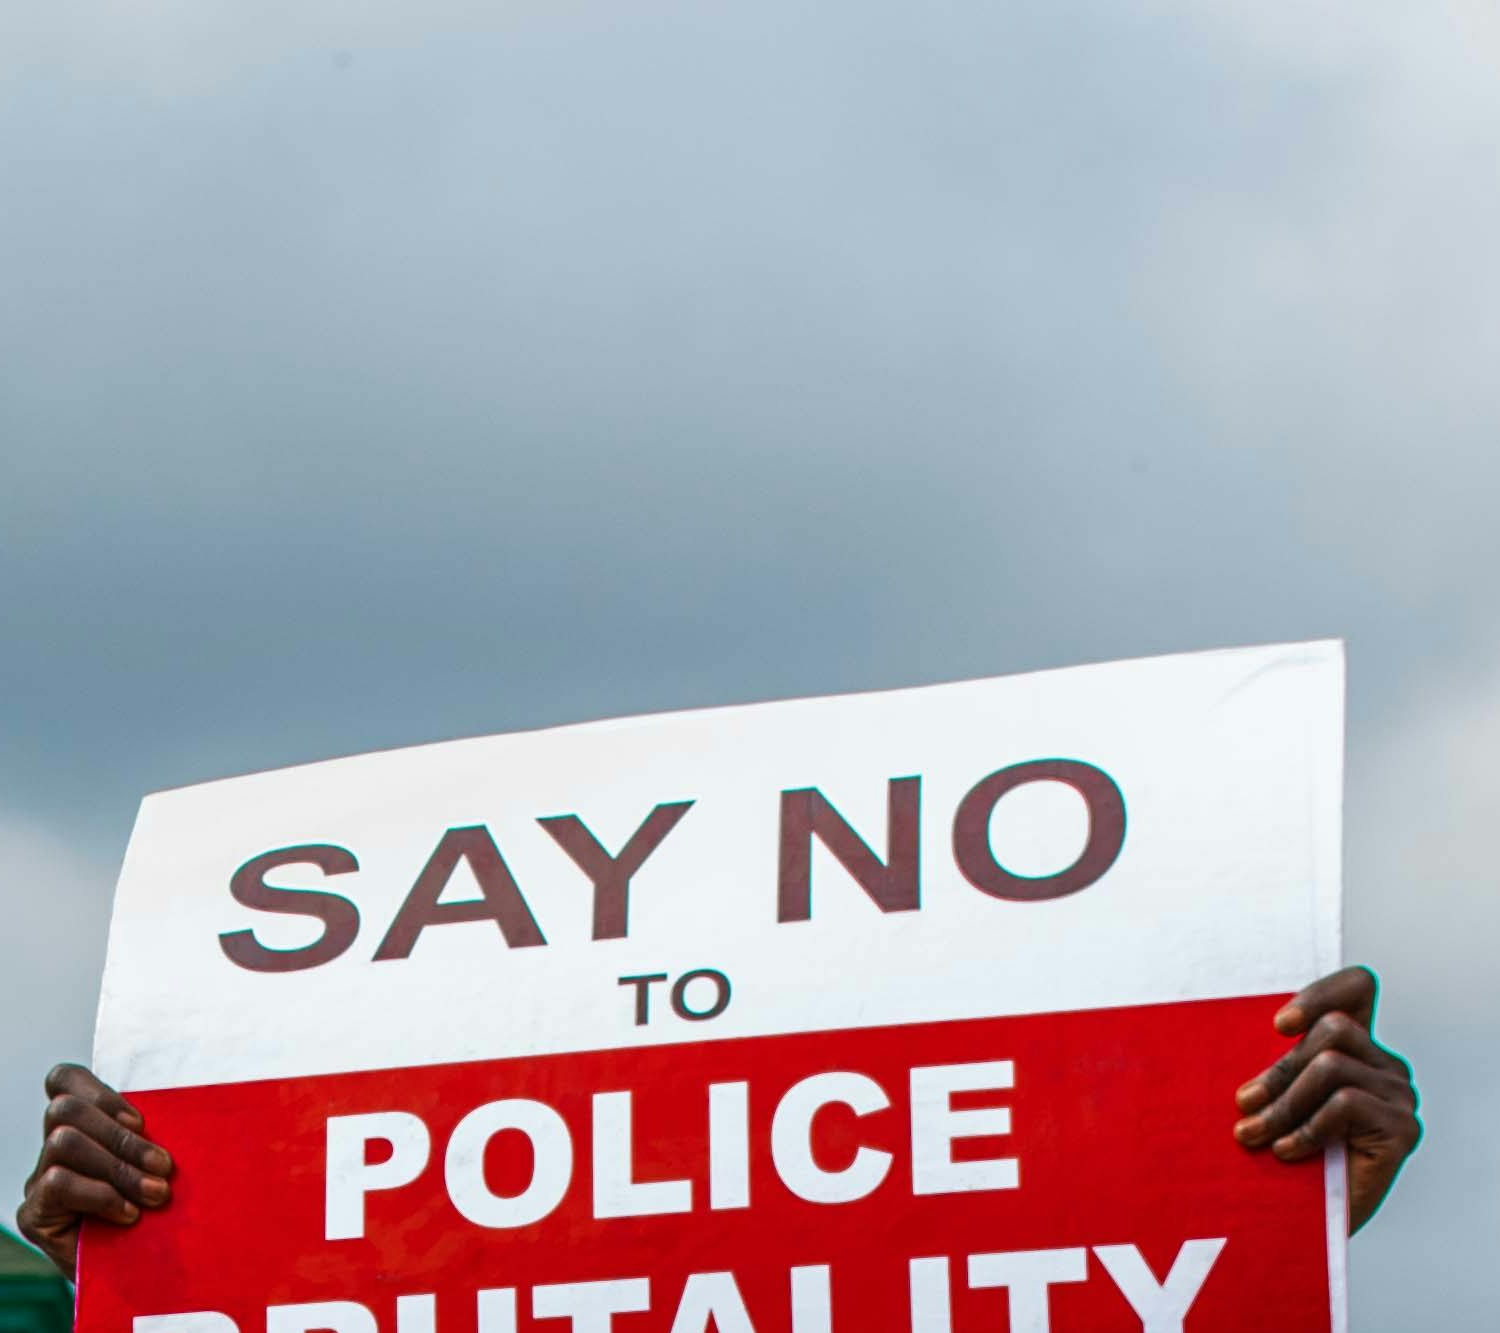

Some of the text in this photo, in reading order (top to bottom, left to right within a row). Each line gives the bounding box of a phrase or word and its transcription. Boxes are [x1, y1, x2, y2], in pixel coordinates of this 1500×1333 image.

[217, 757, 1128, 974] SAY NO
[616, 968, 733, 1027] TO
[324, 1058, 1021, 1242] POLICE
